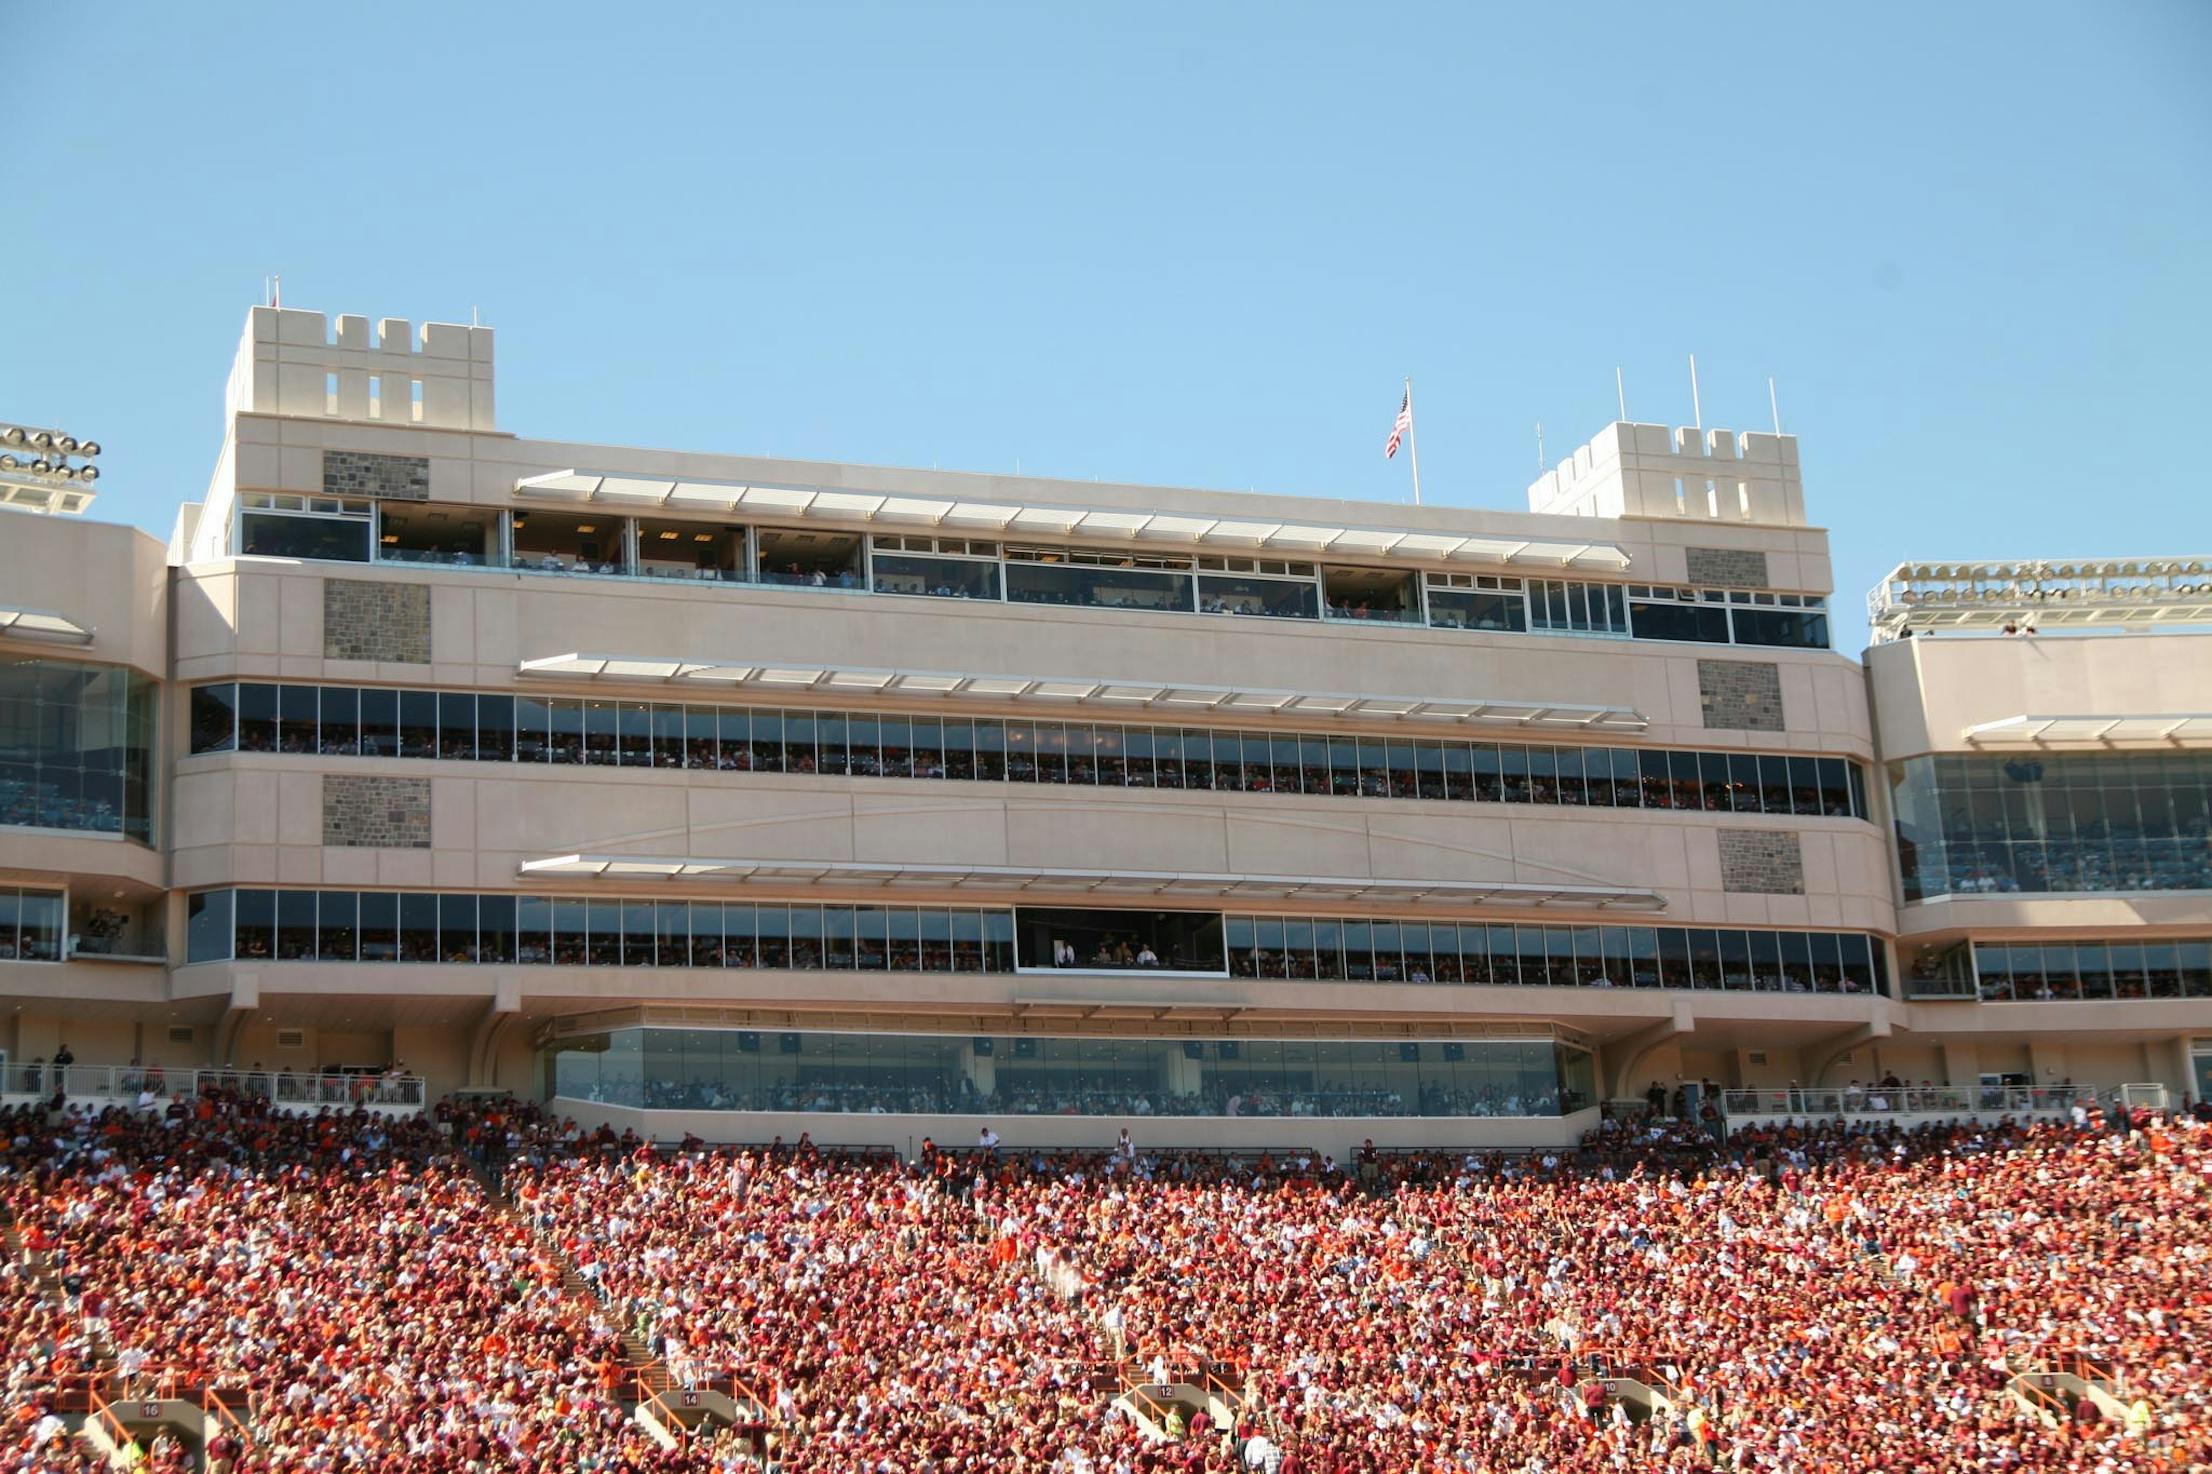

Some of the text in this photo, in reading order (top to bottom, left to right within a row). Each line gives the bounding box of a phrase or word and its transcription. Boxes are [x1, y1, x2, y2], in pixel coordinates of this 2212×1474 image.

[1161, 1386, 1172, 1397] 12
[1605, 1382, 1616, 1392] 10
[685, 1395, 697, 1405] 14
[144, 1405, 158, 1416] 16
